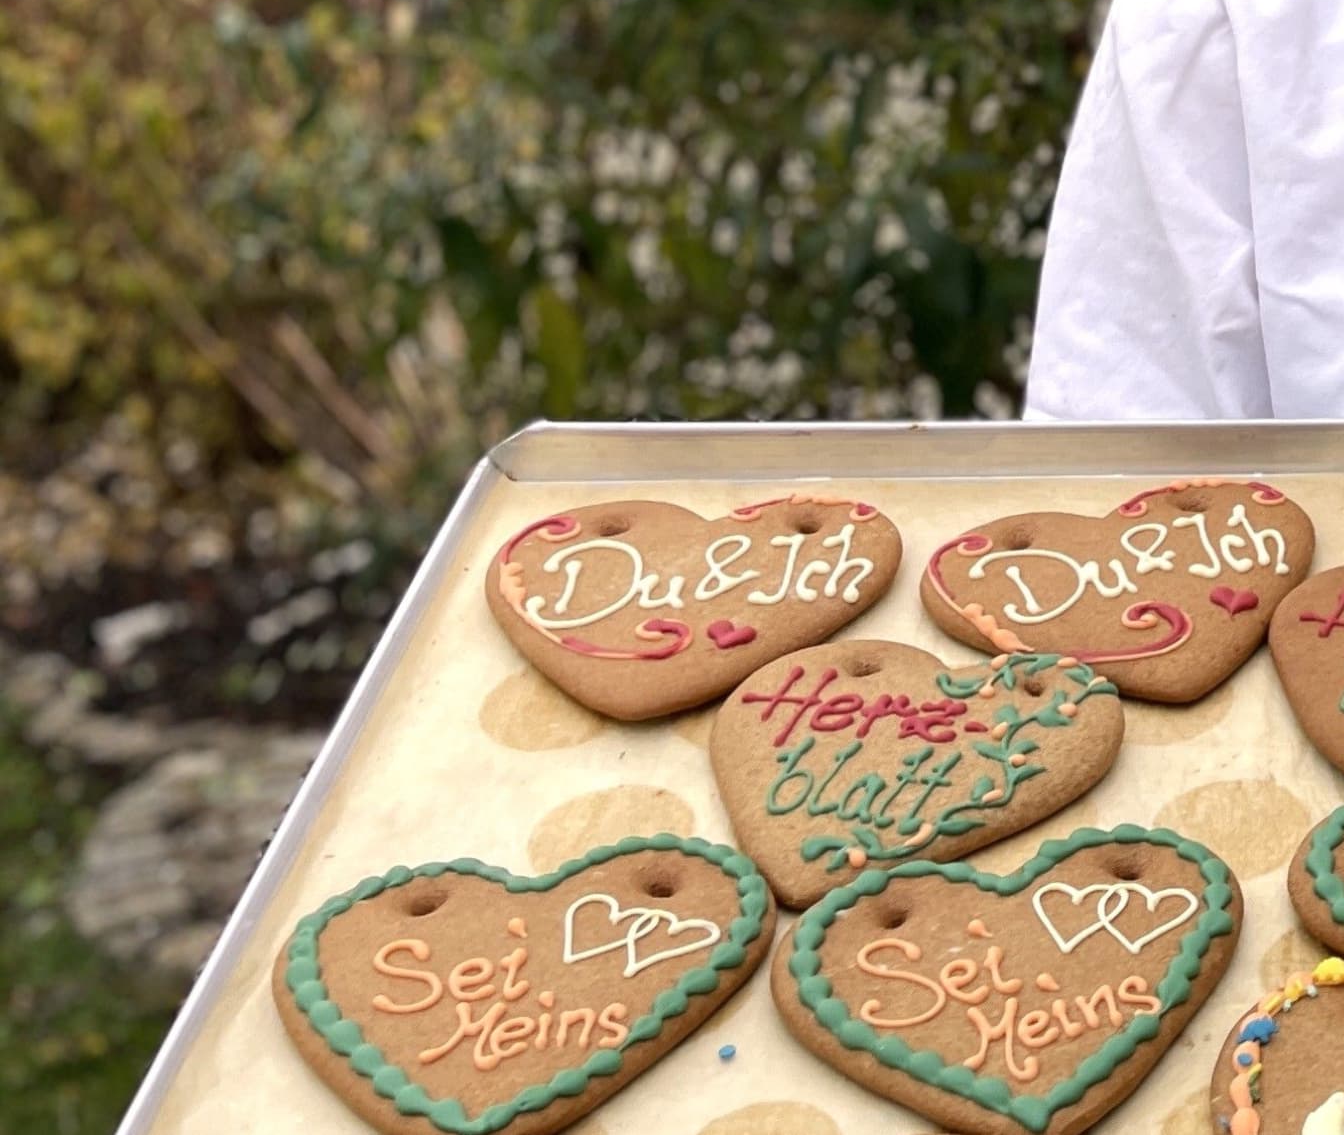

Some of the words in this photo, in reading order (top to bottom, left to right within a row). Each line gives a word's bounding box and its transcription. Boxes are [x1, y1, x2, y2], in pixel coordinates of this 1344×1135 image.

[766, 736, 963, 836] blatt
[372, 916, 532, 1014] Sei
[855, 918, 1020, 1029] Sei
[418, 988, 631, 1072] Meins
[964, 972, 1163, 1081] Meins
